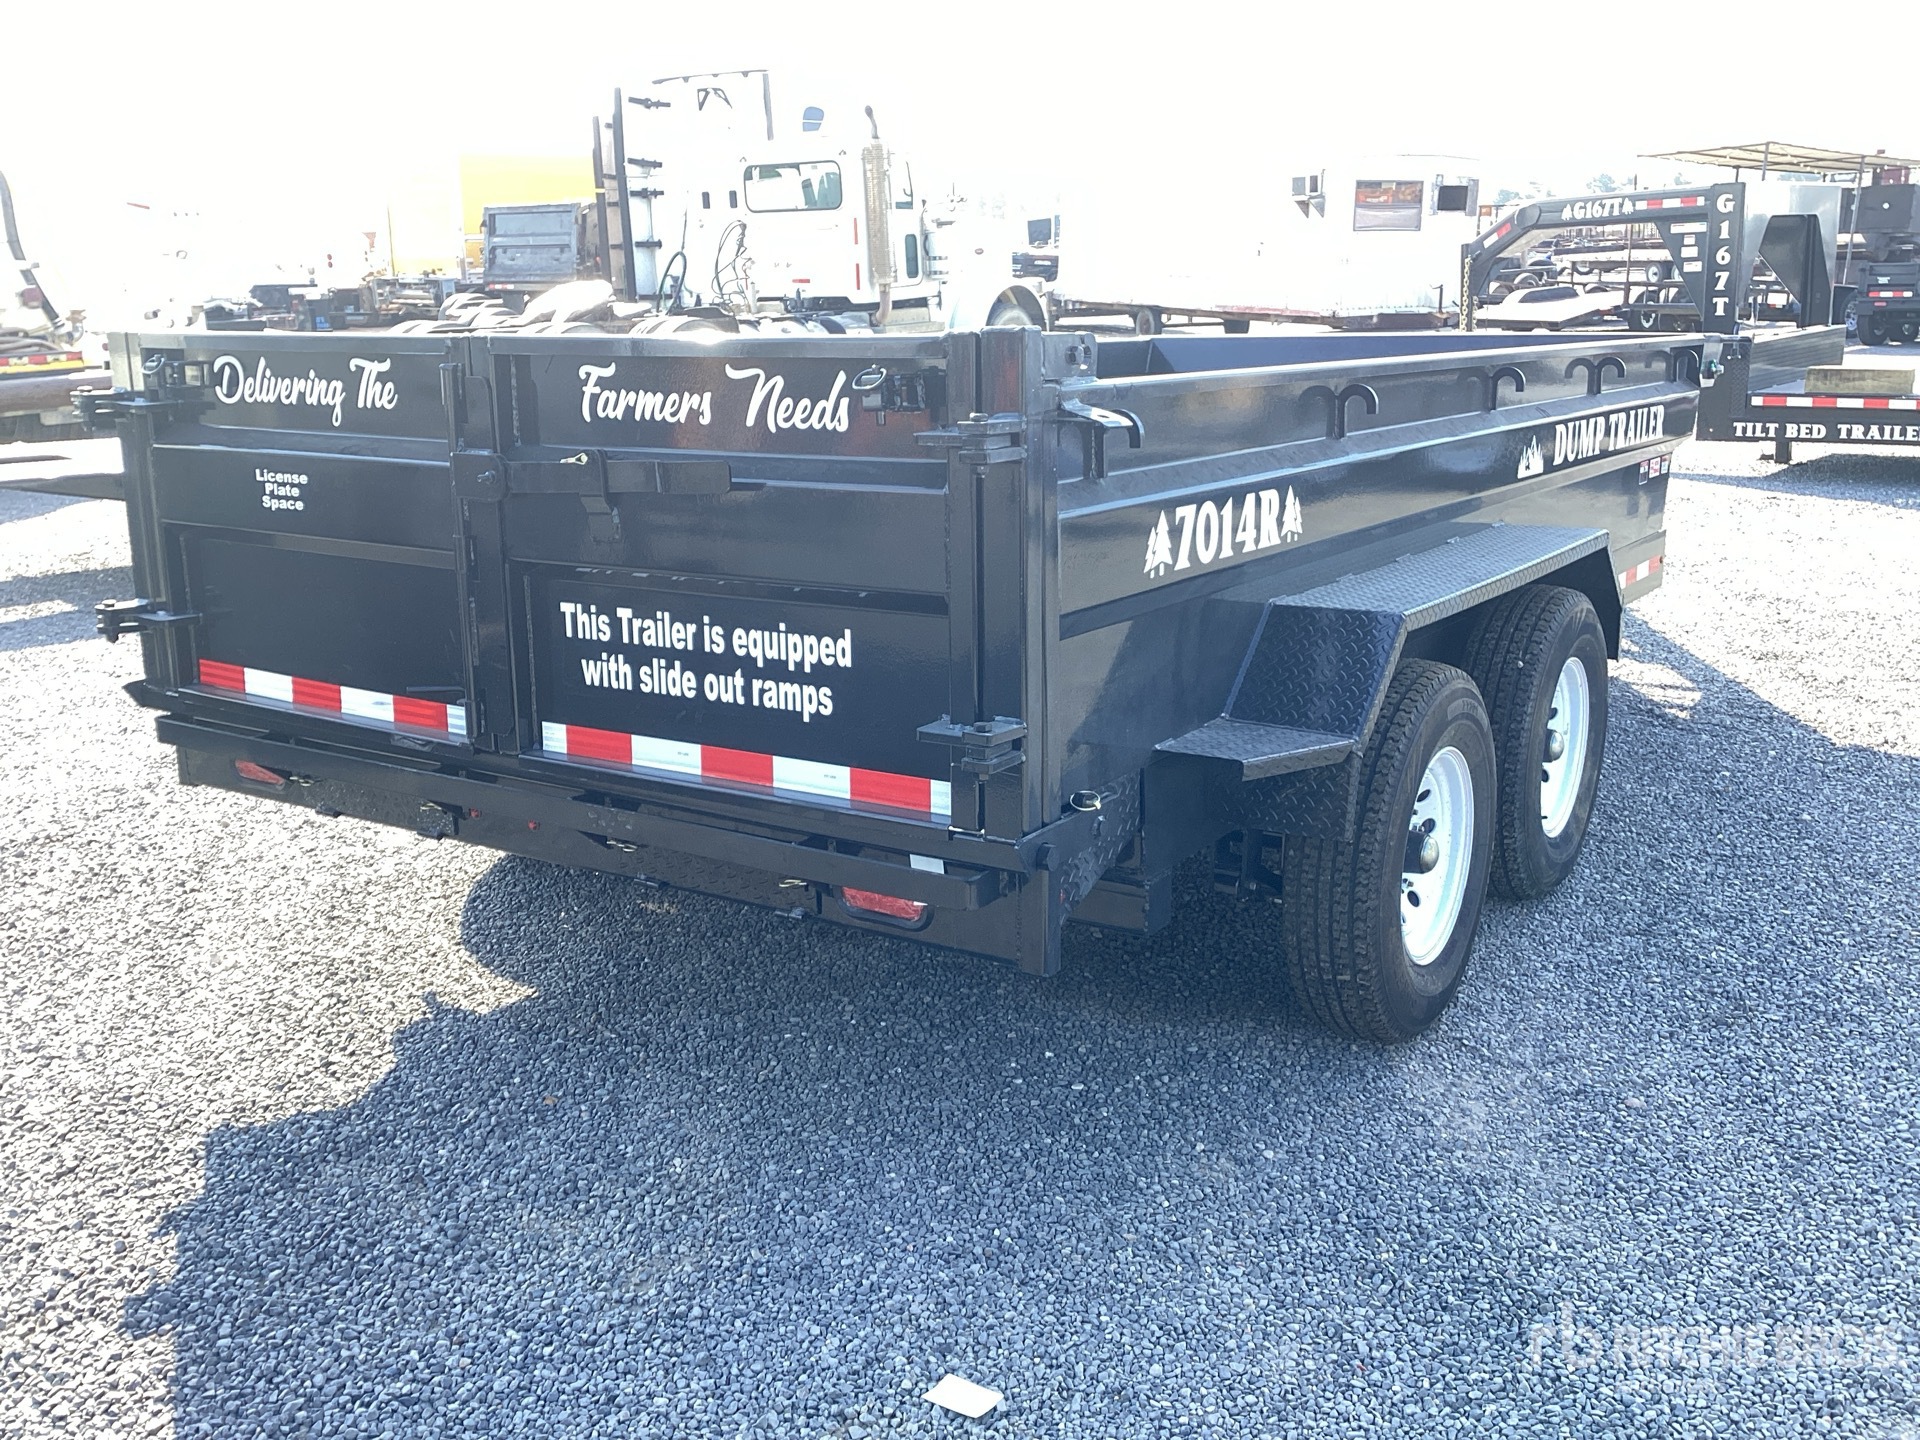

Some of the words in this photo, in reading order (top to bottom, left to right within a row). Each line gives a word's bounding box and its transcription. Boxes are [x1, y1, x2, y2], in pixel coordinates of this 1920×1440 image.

[1573, 198, 1623, 219] G167T
[213, 355, 346, 427] Delivering
[350, 358, 398, 410] The
[578, 361, 712, 424] Farmers
[725, 363, 850, 434] Needs
[1553, 415, 1606, 466] DUMP
[1608, 405, 1664, 452] TRAILER
[1733, 422, 1779, 438] TILT
[1785, 423, 1827, 439] BED
[1837, 424, 1920, 441] TRAILE
[255, 469, 308, 485] License
[262, 495, 304, 512] Space
[265, 483, 300, 497] Plate
[1173, 488, 1282, 571] 7014R
[560, 602, 611, 642] This
[616, 607, 697, 651] Trailer
[703, 616, 725, 654] is
[733, 623, 852, 674] equipped
[581, 652, 633, 691] with
[639, 657, 697, 699] slide
[703, 667, 745, 705] out
[752, 678, 834, 722] ramps
